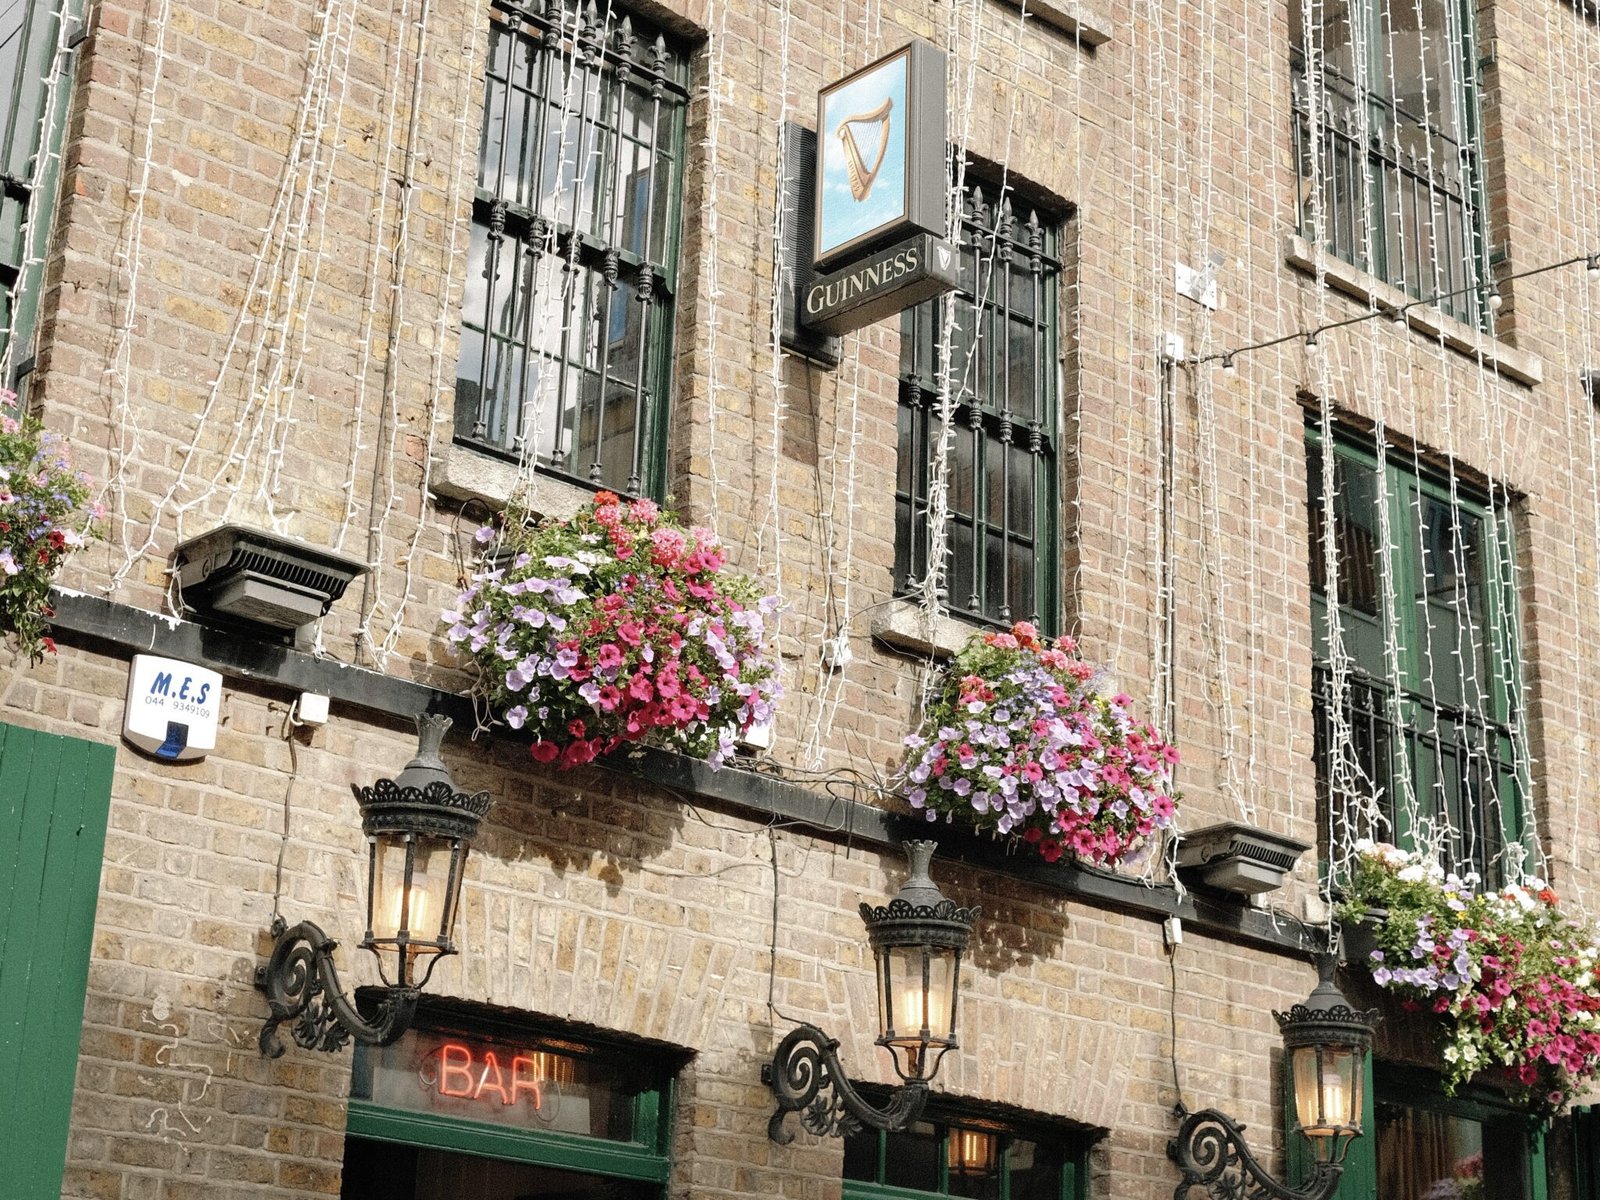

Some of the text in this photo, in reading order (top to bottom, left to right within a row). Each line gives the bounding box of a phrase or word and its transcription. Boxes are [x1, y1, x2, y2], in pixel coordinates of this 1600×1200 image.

[806, 248, 918, 314] GUINNESS
[145, 695, 210, 718] 044 9349109
[150, 671, 210, 704] M.E.S
[440, 1044, 542, 1110] BAR
